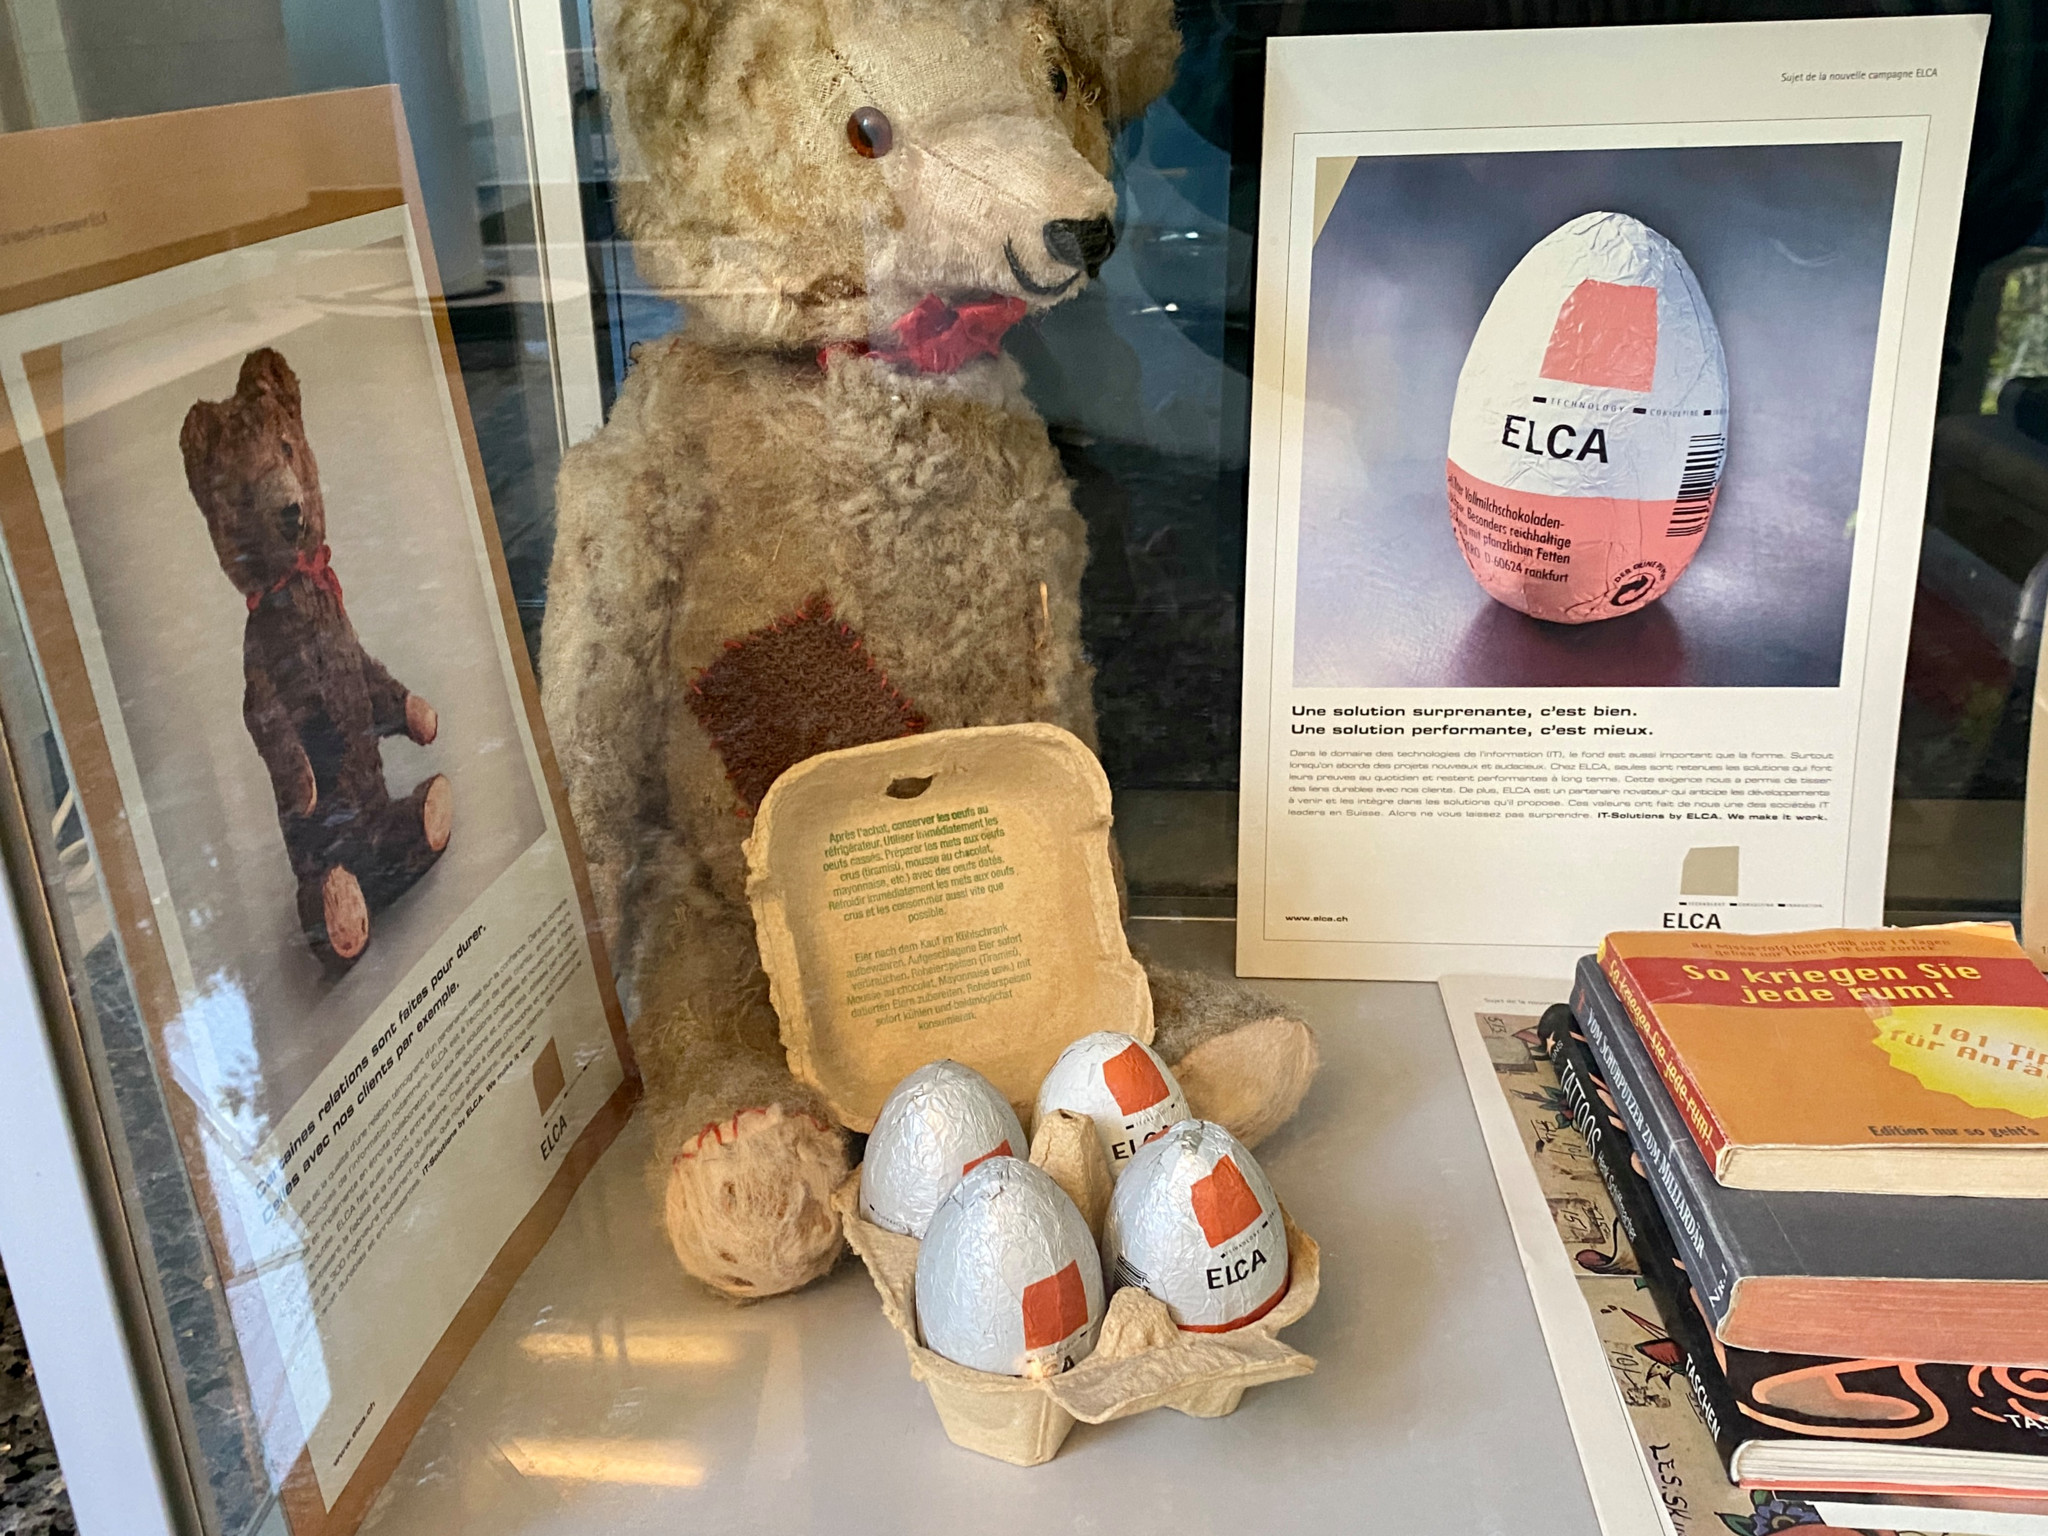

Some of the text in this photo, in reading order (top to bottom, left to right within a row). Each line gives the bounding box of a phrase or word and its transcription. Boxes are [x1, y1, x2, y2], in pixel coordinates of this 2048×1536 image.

[1781, 68, 1938, 84] Sujet de la nouvelle campagne ELCA
[1502, 414, 1608, 464] ELCA
[1467, 508, 1507, 535] Besonders
[1510, 527, 1572, 550] reichhaltige
[1536, 548, 1570, 564] Fetten
[1292, 705, 1636, 718] Une solution surprenante, c'est bien.
[1291, 724, 1652, 737] Une solution performante, c'est mieux.
[1289, 749, 1315, 757] Dans
[1546, 750, 1565, 758] (IT),
[1581, 750, 1605, 758] fond
[1659, 751, 1712, 759] important
[1750, 751, 1786, 759] forme.
[1790, 751, 1834, 759] Surtout
[1289, 761, 1333, 769] lorsqu'on
[1550, 762, 1576, 770] Chez
[1578, 762, 1610, 771] ELCA,
[830, 830, 855, 844] Après
[891, 816, 935, 830] conserver
[936, 812, 950, 822] les
[952, 808, 976, 820] oeufs
[977, 806, 988, 814] au
[1669, 812, 1682, 820] by
[1663, 912, 1722, 930] ELCA
[1682, 962, 1982, 987] So kriegen Sie
[1740, 983, 1955, 1004] jede rum!
[318, 1056, 368, 1121] relations
[372, 1022, 397, 1057] sont
[399, 986, 428, 1024] faites
[431, 957, 454, 991] pour
[456, 924, 486, 959] durer.
[1932, 1023, 1988, 1048] 101
[1890, 1029, 2048, 1079] für Anfä
[302, 1134, 330, 1173] avec
[332, 1104, 354, 1136] nos
[356, 1056, 394, 1105] clients
[397, 1032, 414, 1061] par
[416, 982, 460, 1032] exemple.
[1560, 1058, 1602, 1160] TATTOOS
[1664, 1057, 1688, 1100] jede
[1687, 1096, 1714, 1146] rum!
[540, 1115, 568, 1161] ELCA
[1641, 1123, 1660, 1158] ZUM
[1868, 1125, 2040, 1138] Edition nur so geht's
[1206, 1249, 1268, 1290] ELCA
[1686, 1352, 1720, 1442] TASCHEN
